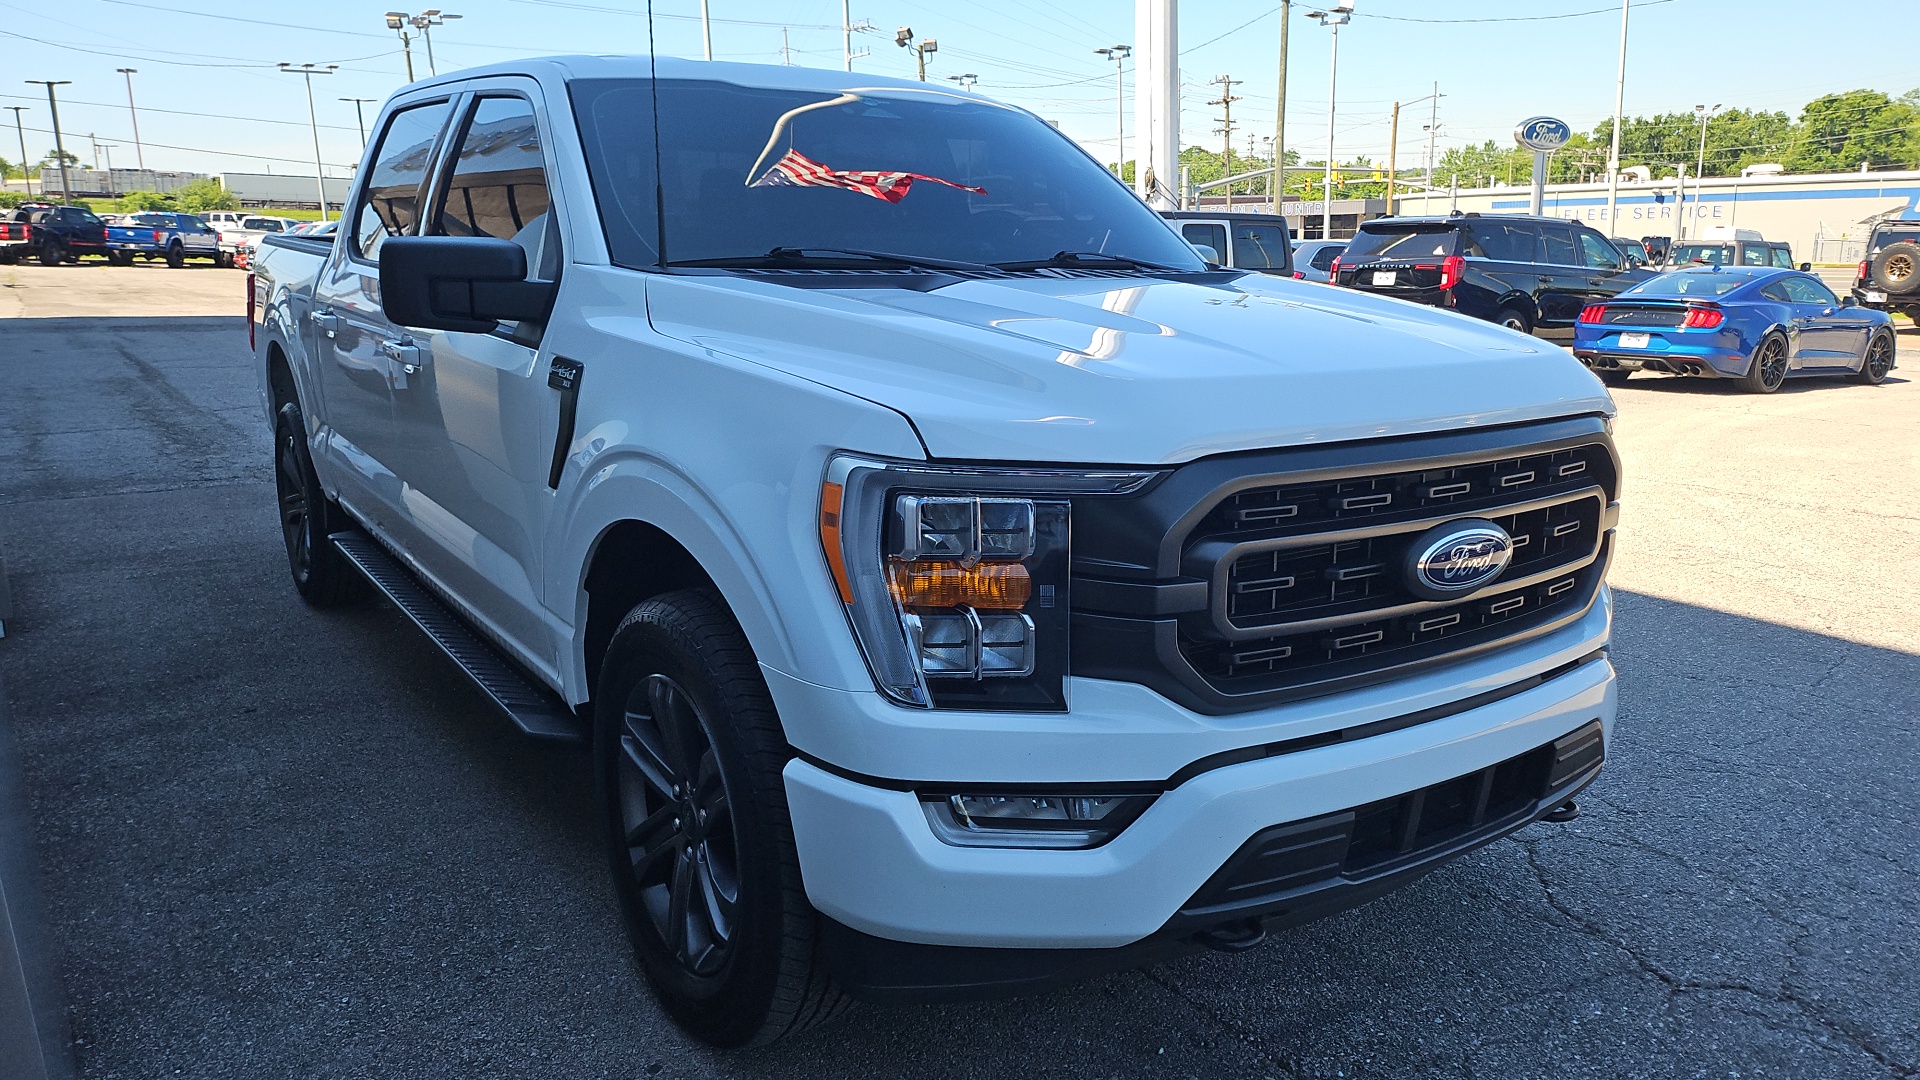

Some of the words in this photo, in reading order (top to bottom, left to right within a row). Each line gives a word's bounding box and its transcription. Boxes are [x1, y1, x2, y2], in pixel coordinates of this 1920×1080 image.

[1532, 122, 1563, 143] Ford
[1564, 208, 1622, 221] FLEET
[1633, 205, 1723, 220] SERICE
[1443, 540, 1497, 579] Ford
